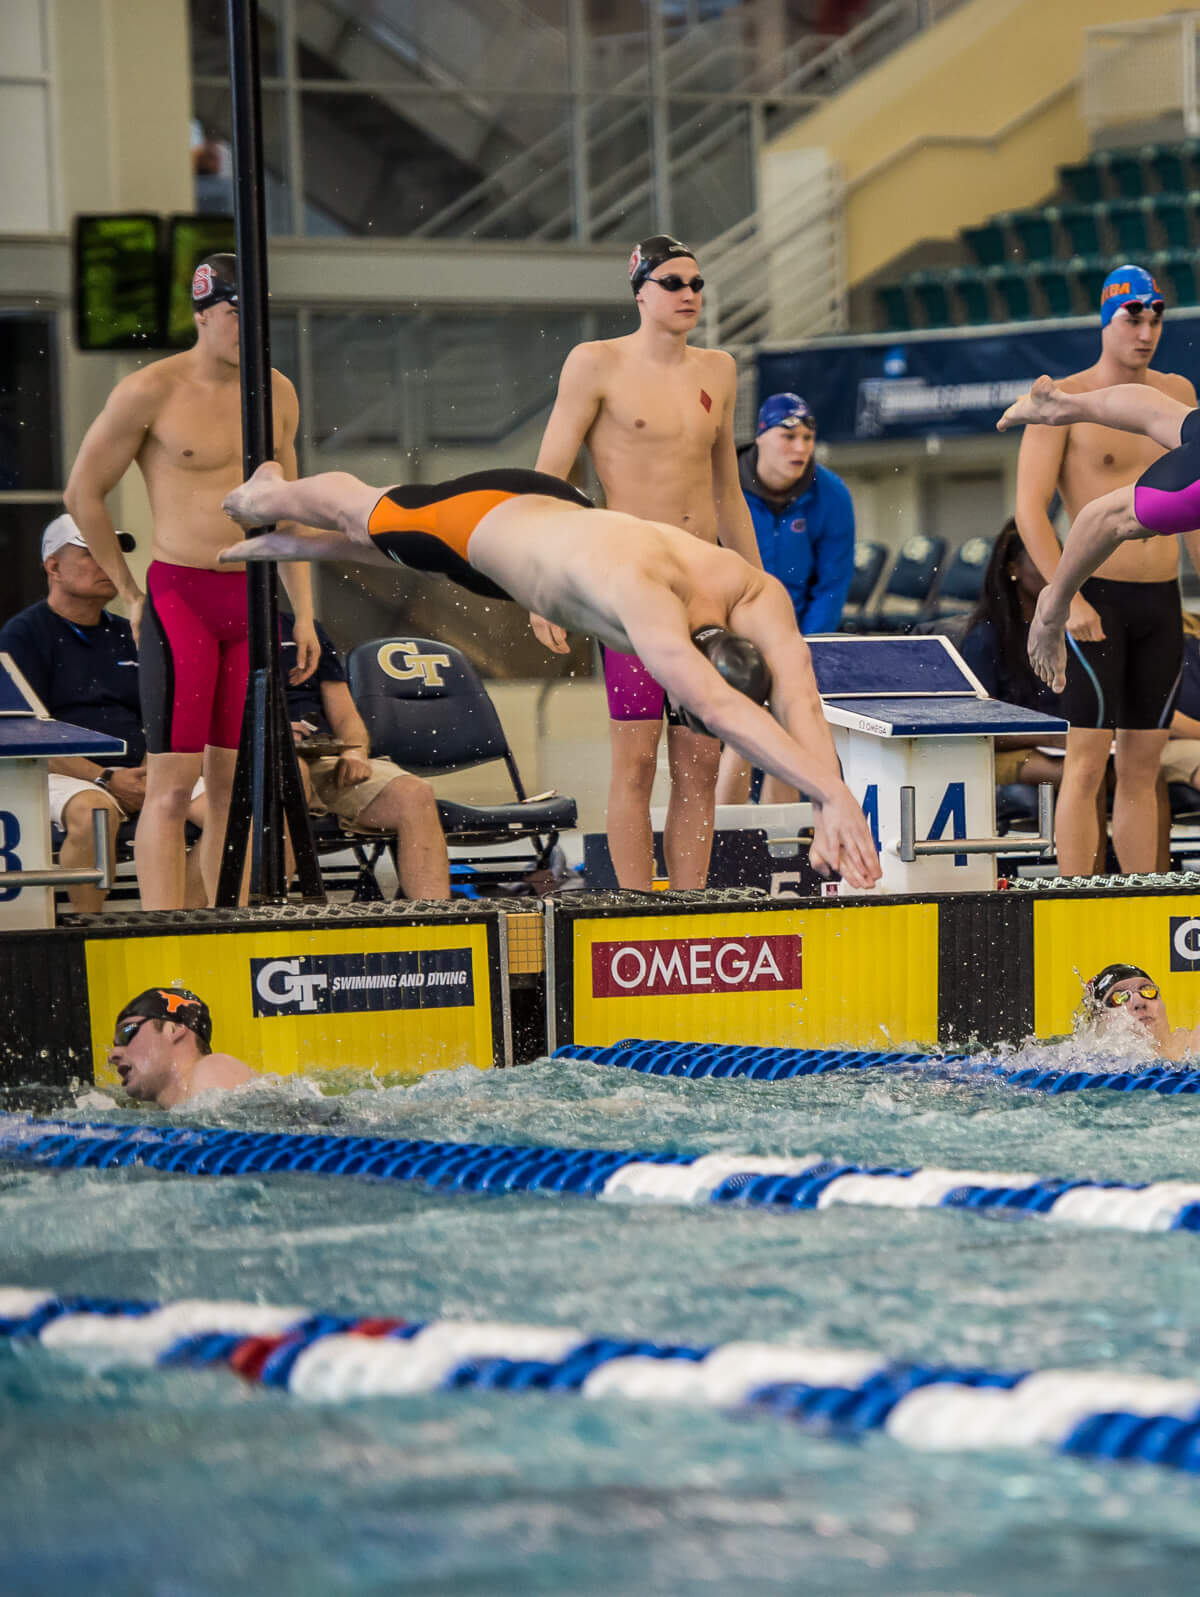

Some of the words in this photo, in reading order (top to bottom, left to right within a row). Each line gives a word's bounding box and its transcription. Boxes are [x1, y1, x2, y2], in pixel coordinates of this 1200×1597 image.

[377, 641, 451, 687] GT
[925, 781, 968, 867] 4
[256, 959, 328, 1011] GT
[332, 973, 397, 991] SWIMMING
[398, 972, 425, 988] AND
[426, 970, 468, 987] DIVING
[611, 940, 785, 989] OMEGA
